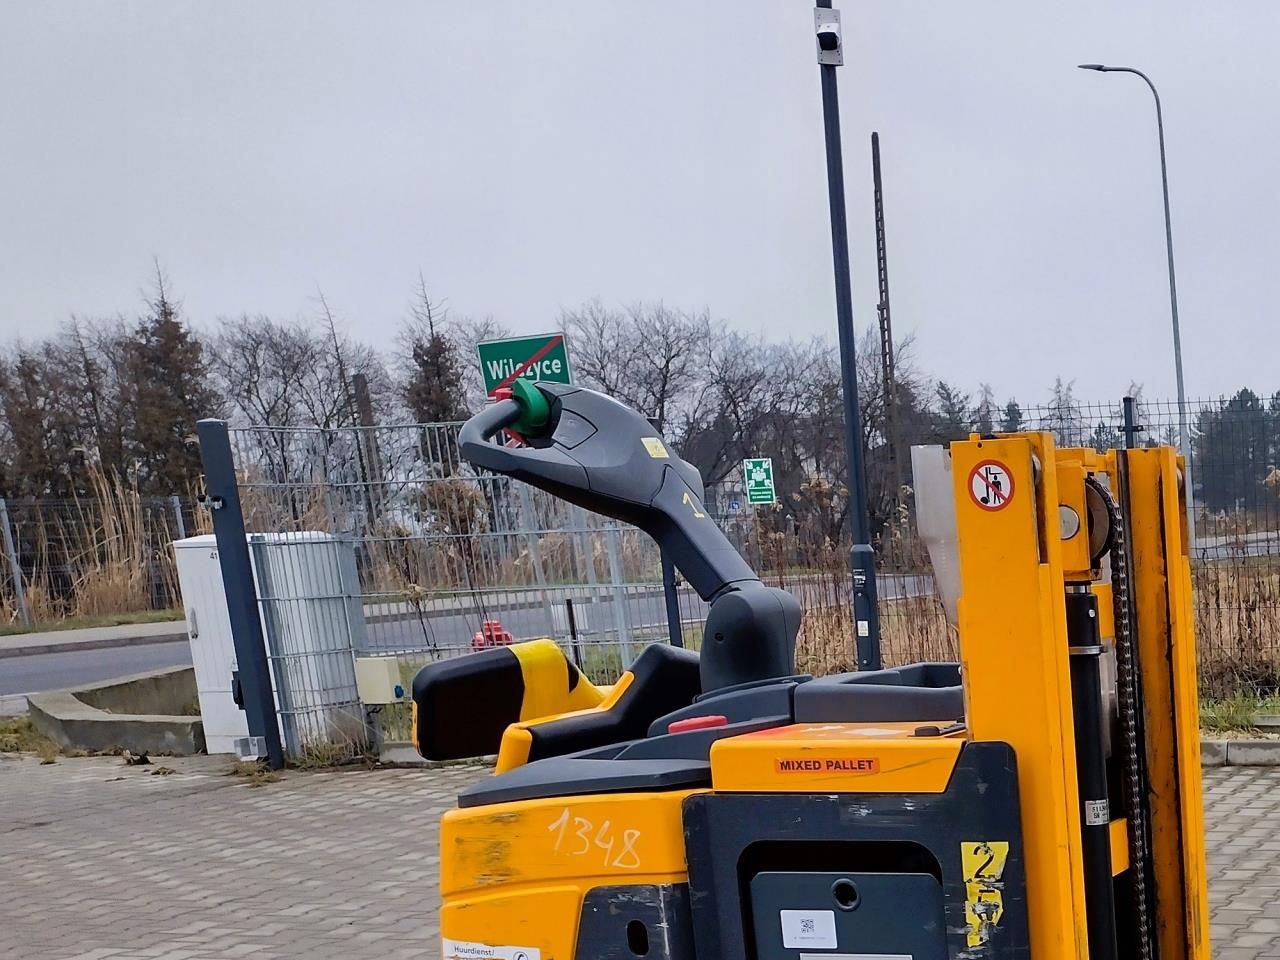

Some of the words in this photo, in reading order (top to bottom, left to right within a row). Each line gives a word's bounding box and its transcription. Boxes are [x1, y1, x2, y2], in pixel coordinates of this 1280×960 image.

[487, 358, 562, 382] Wilczyce
[780, 760, 822, 771] MIXED
[826, 760, 874, 770] PALLET
[547, 807, 641, 869] 1348
